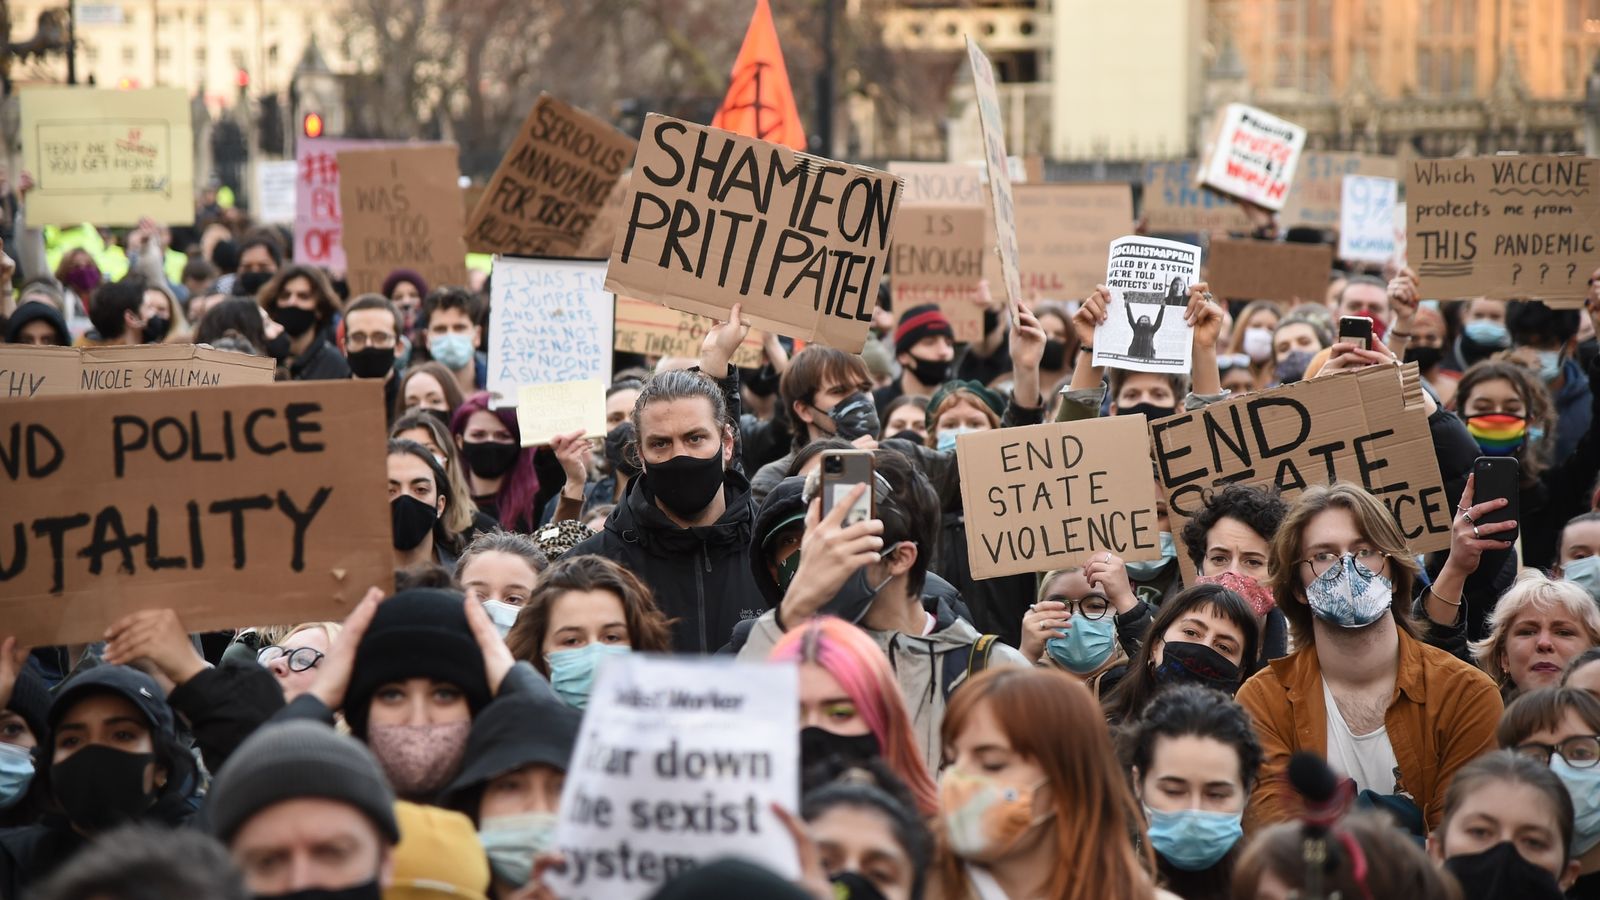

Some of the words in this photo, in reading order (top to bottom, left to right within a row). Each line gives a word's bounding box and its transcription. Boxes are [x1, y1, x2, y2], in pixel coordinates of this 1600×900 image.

[530, 99, 625, 177] SERIOUS
[49, 158, 78, 173] YOU
[1415, 161, 1476, 187] Which
[1491, 160, 1593, 187] VACCINE
[355, 183, 411, 213] WAS
[491, 174, 538, 219] FOR
[643, 121, 847, 238] SHAME
[837, 176, 898, 250] ON
[385, 212, 430, 238] TOO
[925, 214, 955, 236] IS
[1416, 200, 1491, 223] protects
[1503, 204, 1525, 216] me
[1533, 203, 1574, 220] from
[363, 237, 433, 264] DRUNK
[620, 191, 768, 296] PRITI
[763, 229, 877, 323] PATEL
[1111, 244, 1154, 259] SOCIALIST
[1158, 248, 1194, 264] APPEAL
[1416, 229, 1478, 261] THIS
[1493, 232, 1595, 257] PANDEMIC
[894, 244, 984, 278] ENOUGH
[1137, 261, 1149, 270] BY
[1151, 262, 1158, 271] A
[1160, 263, 1194, 275] SYSTEM
[1511, 262, 1522, 286] ?
[1538, 262, 1550, 285] ?
[1566, 262, 1577, 285] ?
[501, 266, 518, 287] I
[526, 267, 565, 288] WAS
[1135, 270, 1156, 280] TOLD
[1152, 282, 1164, 291] US
[503, 288, 514, 302] A
[519, 286, 588, 310] JUMPER
[501, 308, 534, 322] AND
[501, 319, 519, 335] I
[524, 320, 559, 337] WAS
[563, 324, 599, 338] NOT
[501, 336, 573, 356] ASKING
[576, 340, 603, 355] FOR
[644, 332, 692, 359] THREAT
[81, 368, 134, 391] NICOLE
[143, 367, 222, 391] SMALLMAN
[500, 365, 552, 382] ASKS
[112, 401, 326, 479] POLICE
[1000, 434, 1084, 473] END
[1152, 396, 1312, 489] END
[987, 470, 1109, 518] STATE
[980, 508, 1156, 565] VIOLENCE
[654, 738, 772, 780] down
[629, 790, 761, 836] sexist
